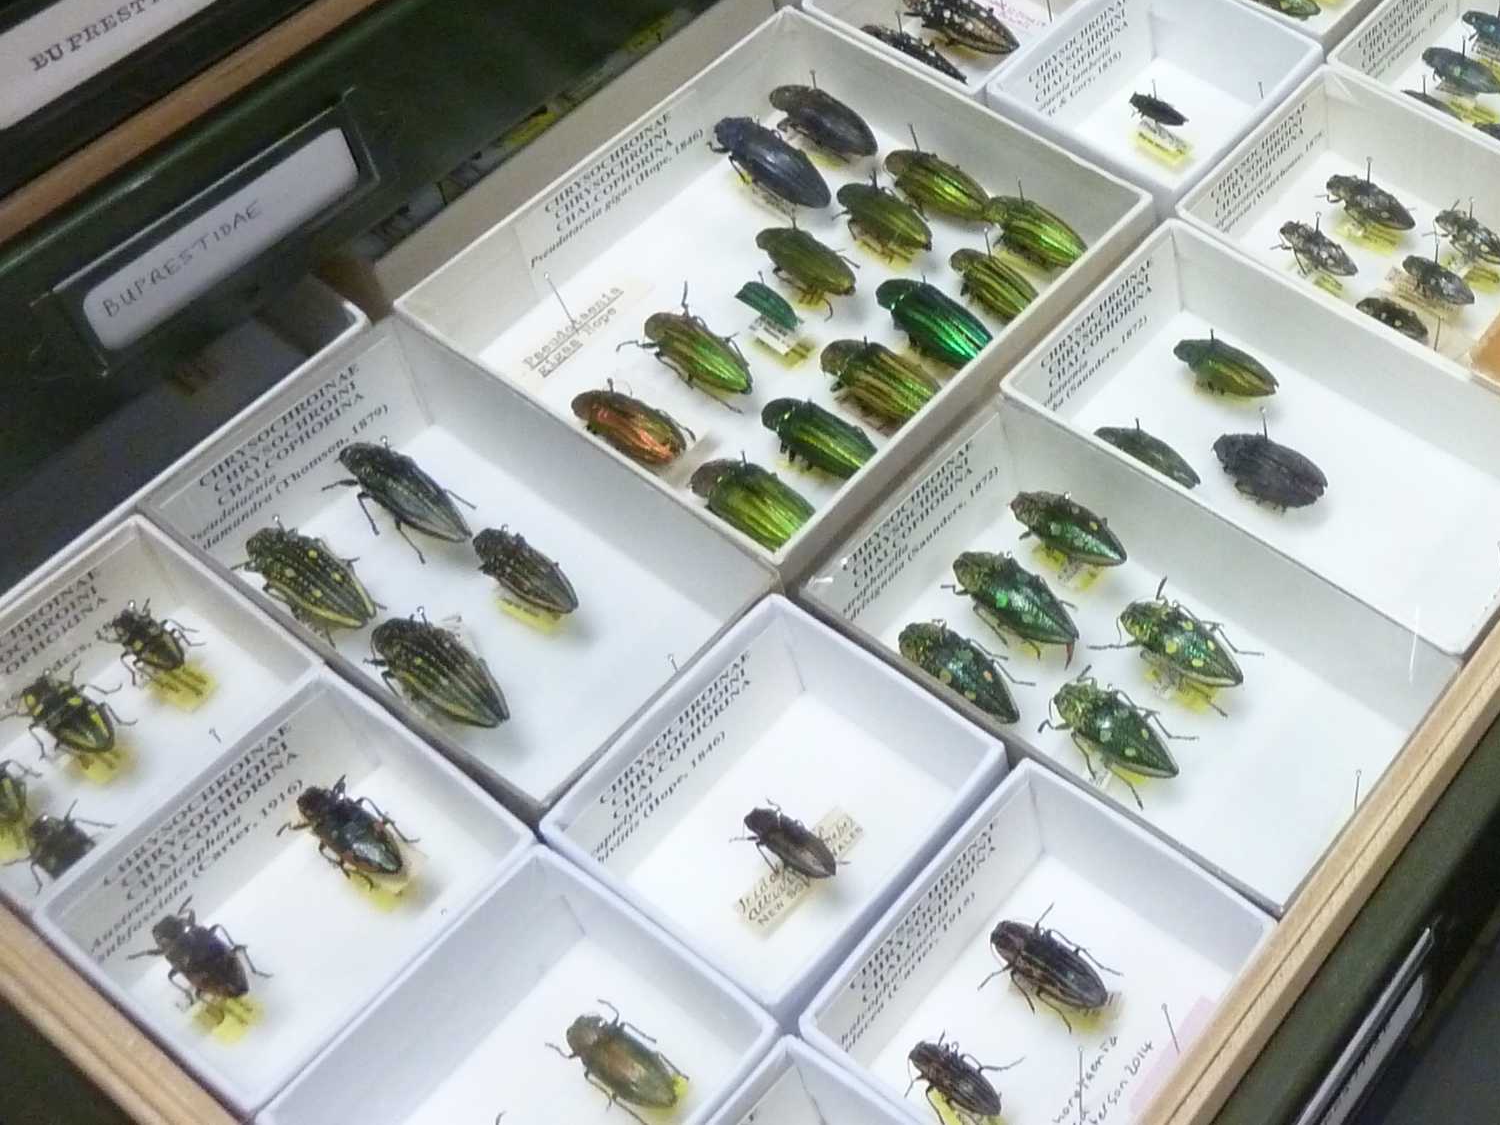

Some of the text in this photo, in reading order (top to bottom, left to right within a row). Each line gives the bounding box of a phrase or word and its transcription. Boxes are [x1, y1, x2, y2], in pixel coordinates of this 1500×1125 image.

[1035, 8, 1125, 89] CHRYSOCHROINI
[1035, 20, 1128, 102] CHALCOPHORINA
[531, 207, 602, 268] Pseudotaenia
[635, 155, 672, 186] (Hope,
[675, 129, 704, 155] 1846)
[544, 112, 672, 213] CHRYSOCHROINAE
[555, 128, 668, 219] CHRYSOCHROINI
[556, 140, 673, 232] CHALCOPHORINA
[101, 199, 263, 318] BUPRESTIDAE
[1040, 258, 1153, 367] CHRYSOCHROINAE
[1049, 274, 1148, 374] CHRYSOCHROINI
[1049, 286, 1152, 387] CHALCOPHORINA
[200, 364, 359, 487] CHRYSOCHROINAE
[214, 381, 356, 492] CHRYSOCHROINI
[218, 392, 364, 505] CHALCOPHORINA
[276, 436, 349, 495] (Thomson,
[351, 404, 388, 435] 1879)
[843, 442, 973, 571] CHRYSOCHROINAE
[852, 457, 969, 575] CHRYSOCHROINI
[854, 468, 973, 588] CHALCOPHORINA
[907, 502, 967, 562] (Saunders,
[970, 467, 999, 498] 1872)
[599, 651, 751, 805] CHRYSOCHROINAE
[611, 669, 745, 806] CHRYSOCHROINI
[613, 680, 750, 819] CHALCOPHORINA
[103, 724, 292, 885] CHRYSOCHROINAE
[120, 743, 287, 887] CHRYSOCHROINI
[126, 752, 298, 900] CHALCOPHORINA
[192, 823, 258, 879] (Carter,
[261, 779, 303, 818] 1916)
[850, 822, 994, 989] CHRYSOCHROINAE
[861, 835, 992, 990] CHRYSOCHROINI
[862, 846, 996, 1003] CHALCOPHORINA
[1124, 1040, 1153, 1076] 2014
